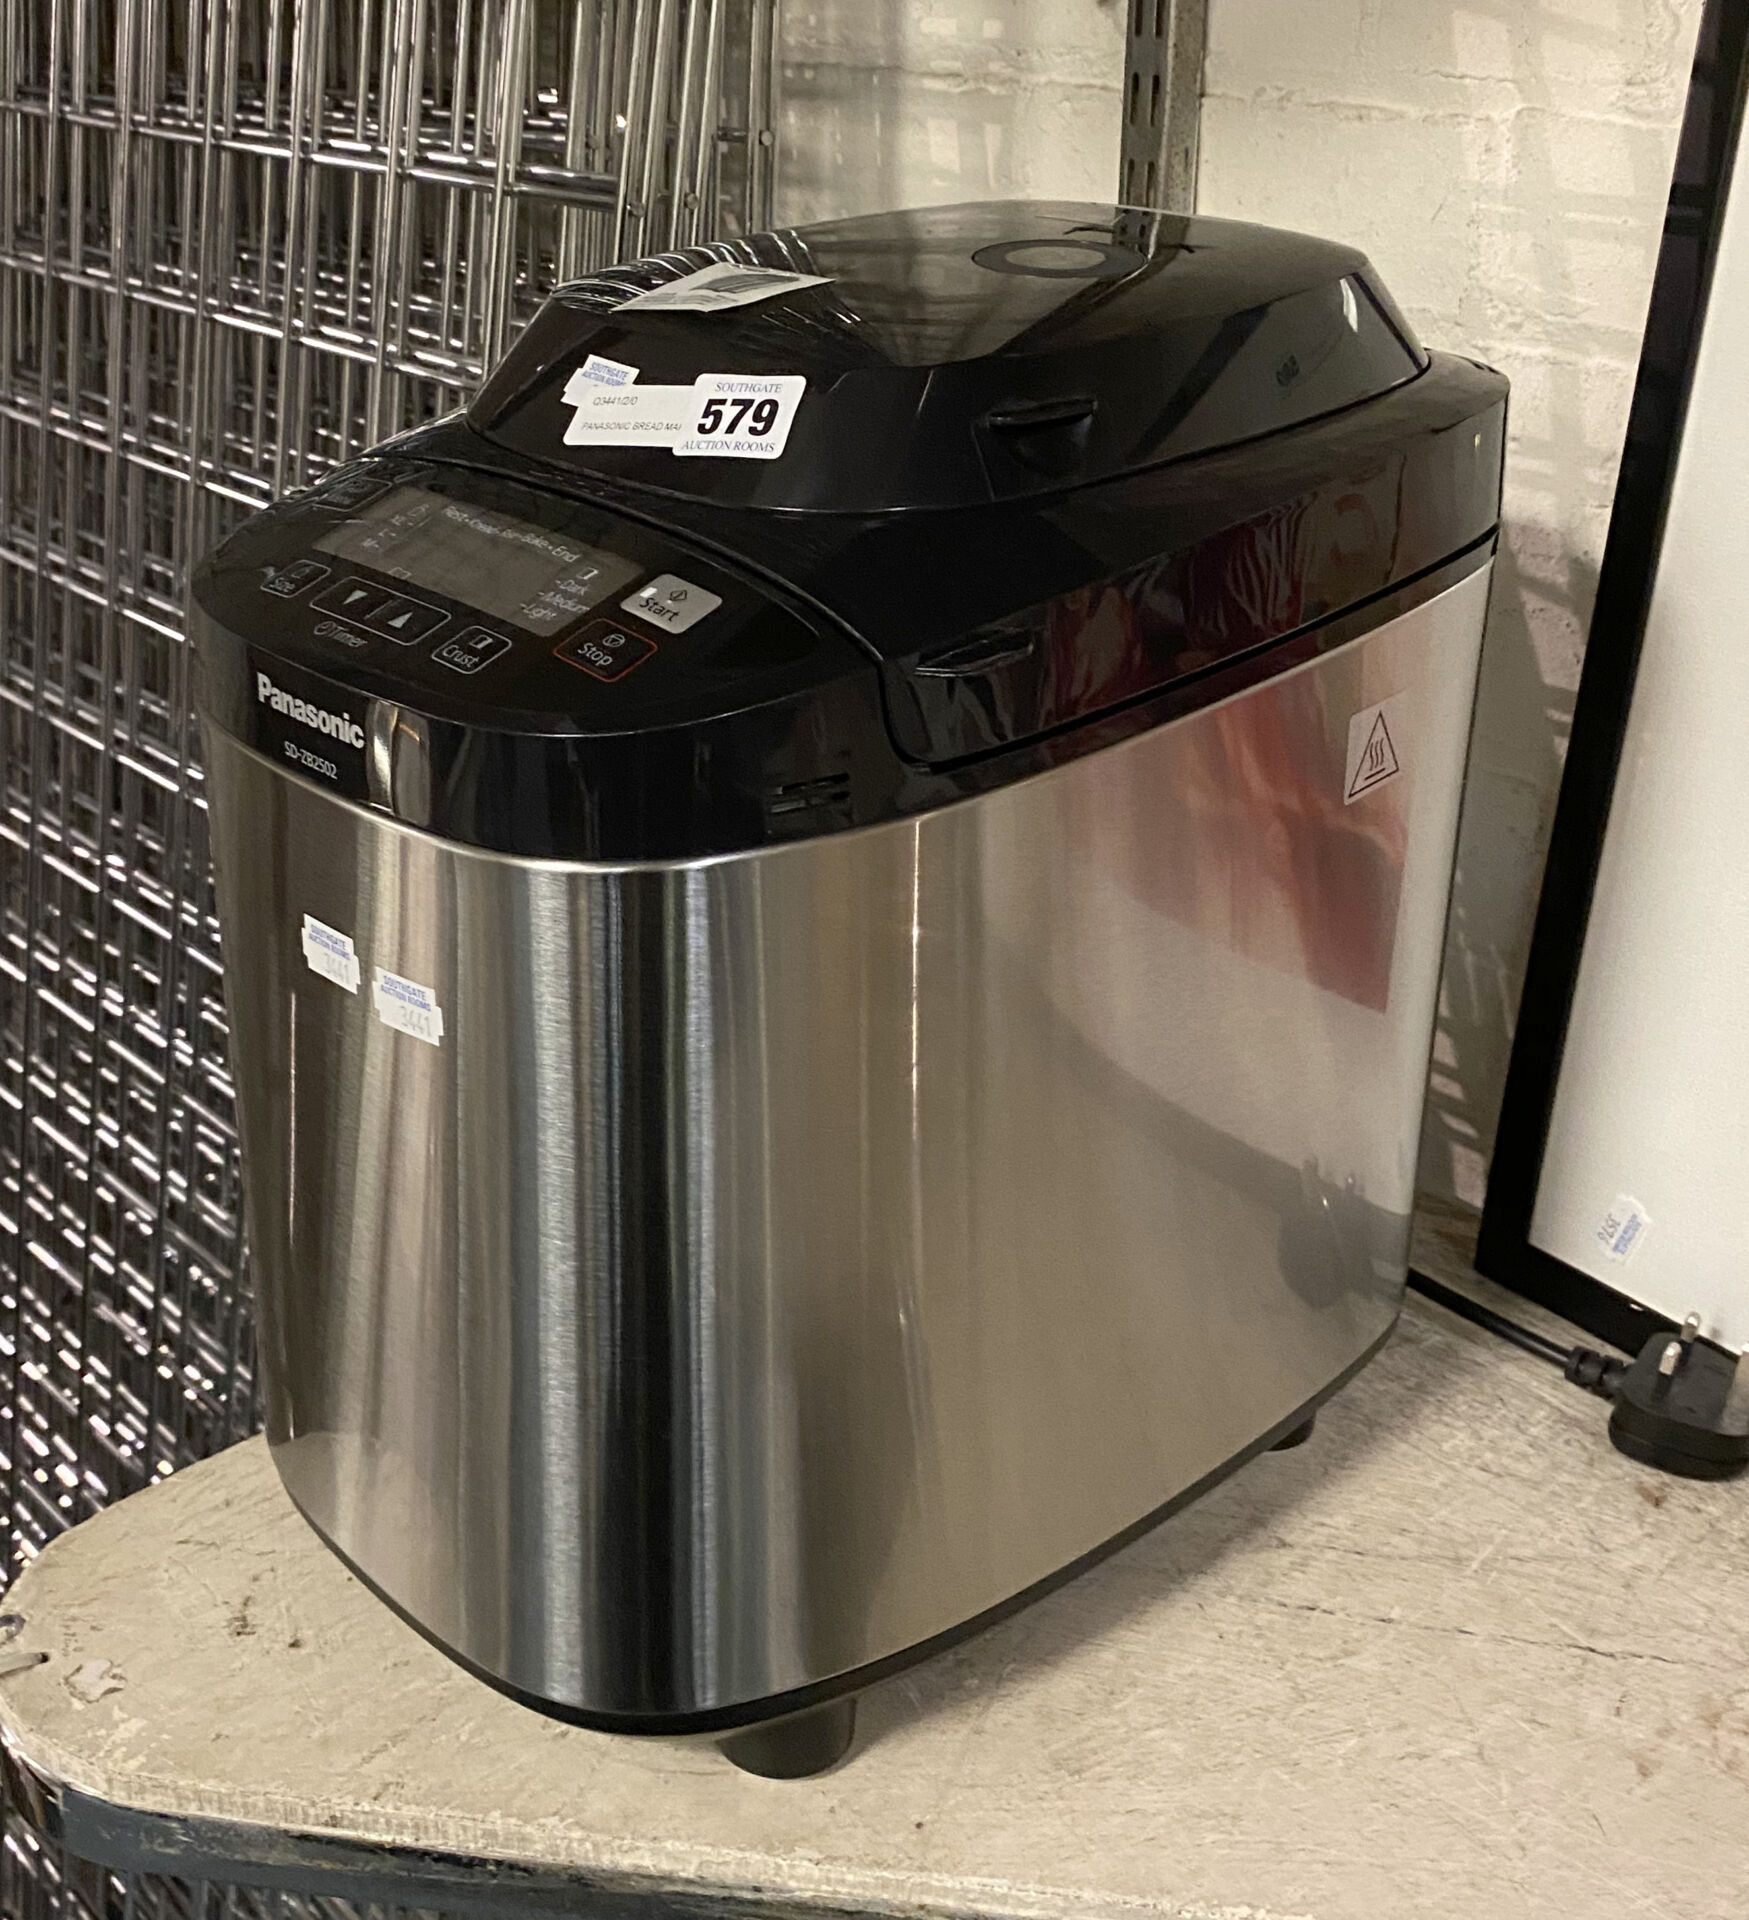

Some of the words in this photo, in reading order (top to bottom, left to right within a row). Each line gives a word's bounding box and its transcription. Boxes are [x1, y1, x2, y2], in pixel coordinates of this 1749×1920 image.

[715, 381, 783, 393] SOUTHGATE
[581, 421, 630, 431] PANASONIC
[632, 421, 664, 431] BREAD
[697, 398, 779, 436] 579
[681, 440, 732, 451] AUCTION
[733, 441, 776, 452] ROOMS
[552, 545, 580, 562] End
[639, 596, 681, 623] Start
[330, 622, 368, 648] Timer
[442, 644, 481, 668] Crust
[577, 641, 613, 667] Stop
[257, 671, 365, 749] Panasonic
[284, 741, 338, 780] SD-ZB2502
